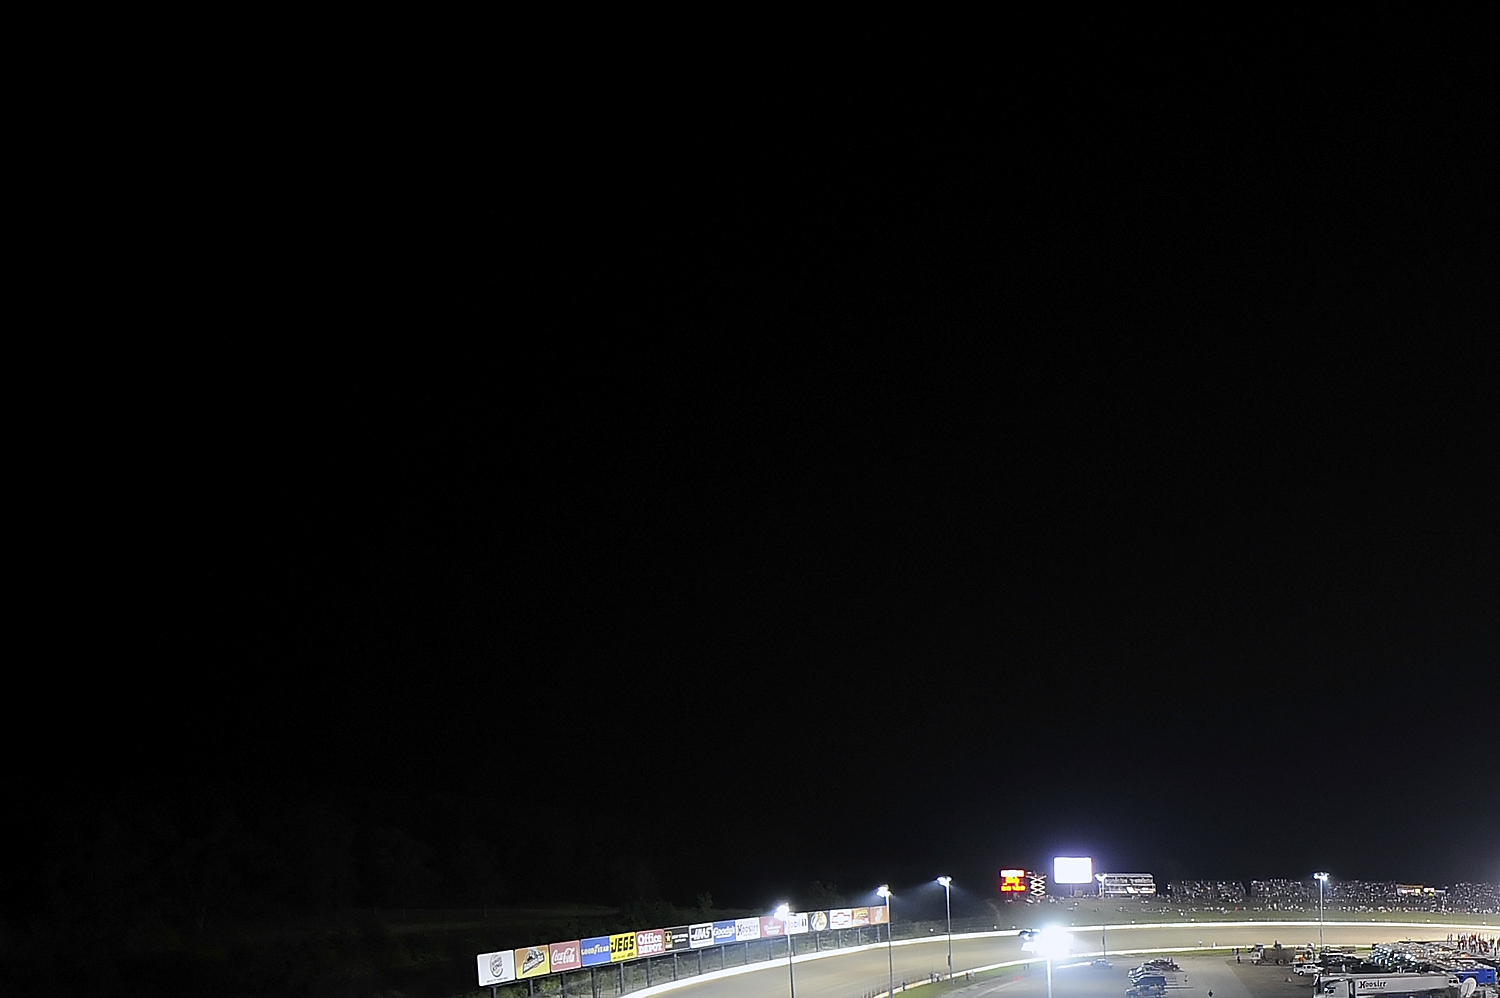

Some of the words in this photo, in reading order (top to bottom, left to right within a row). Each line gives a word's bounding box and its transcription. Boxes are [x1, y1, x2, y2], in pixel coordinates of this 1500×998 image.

[610, 935, 635, 953] JEGS
[637, 932, 662, 945] Office
[581, 944, 610, 955] GOODYEAR
[638, 942, 663, 954] DEPOT
[551, 947, 575, 966] Coca-Cola
[1358, 980, 1387, 988] Hoosier
